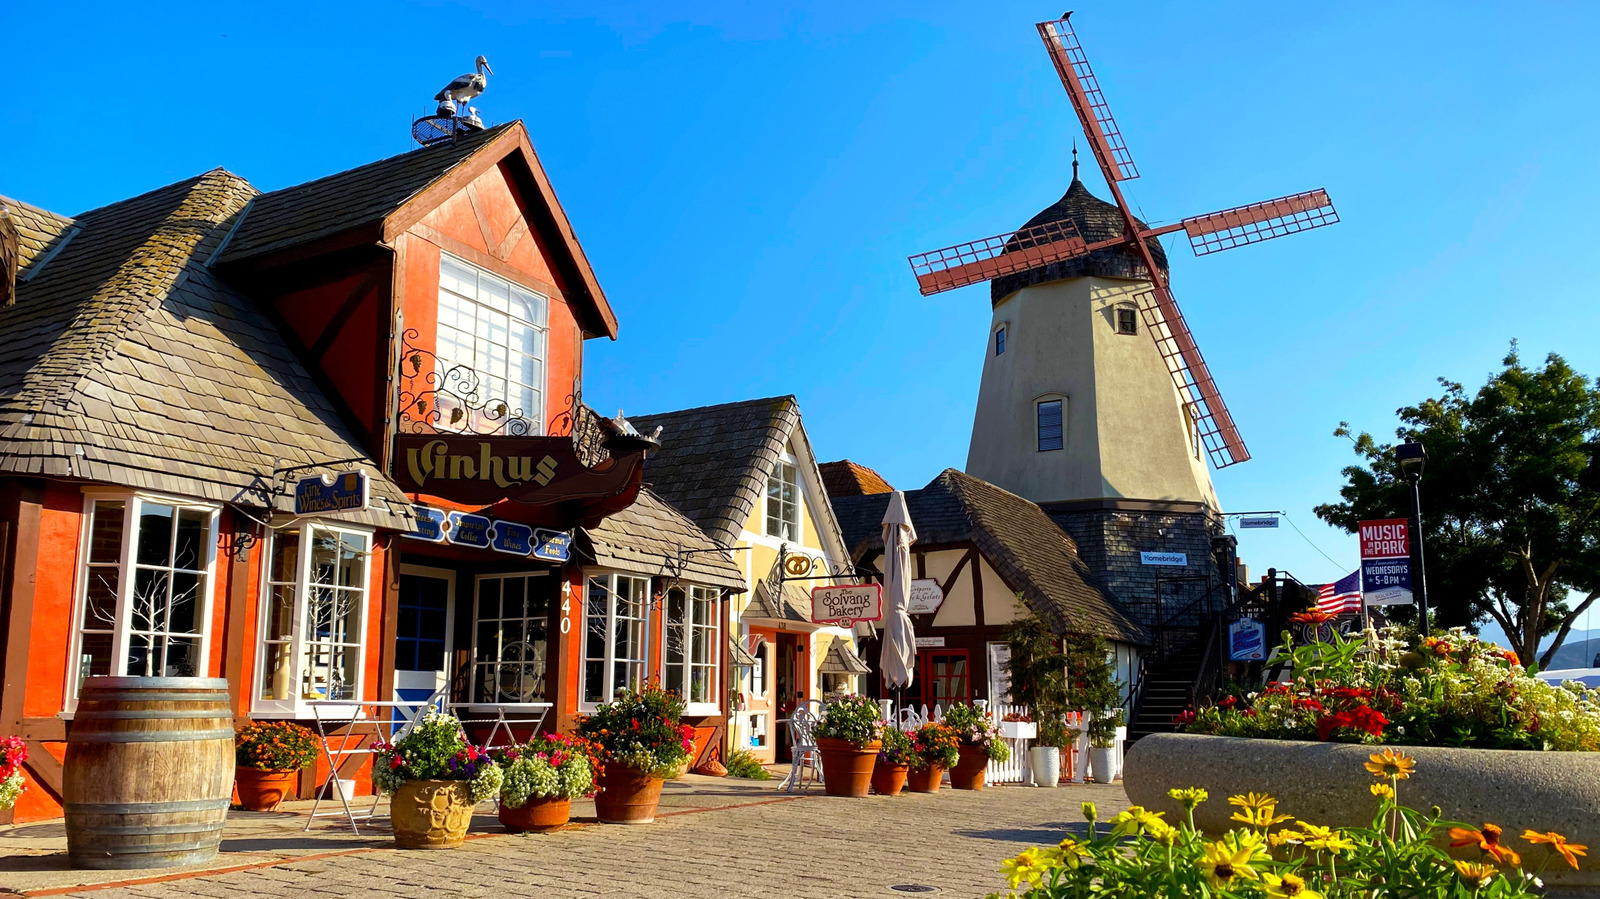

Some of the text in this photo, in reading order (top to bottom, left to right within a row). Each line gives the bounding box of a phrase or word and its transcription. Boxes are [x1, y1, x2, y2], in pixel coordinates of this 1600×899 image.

[406, 440, 558, 488] Vinhus
[304, 483, 320, 497] Fine
[298, 490, 360, 512] Wines & Spirits
[455, 517, 484, 530] Imported
[418, 527, 435, 538] sting
[460, 530, 478, 542] Coffee
[506, 526, 520, 538] Fine
[1362, 525, 1405, 541] MUSIC
[503, 538, 522, 550] Wines
[541, 533, 565, 546] Gourmet
[544, 545, 561, 556] Foods
[1374, 540, 1406, 555] PARK
[1144, 554, 1182, 563] Homebridge
[1365, 565, 1408, 575] WEDNESDAYS
[1375, 575, 1399, 585] 5-8 PM
[823, 591, 871, 608] Solvang
[560, 580, 571, 634] 440
[829, 605, 864, 619] Bakery
